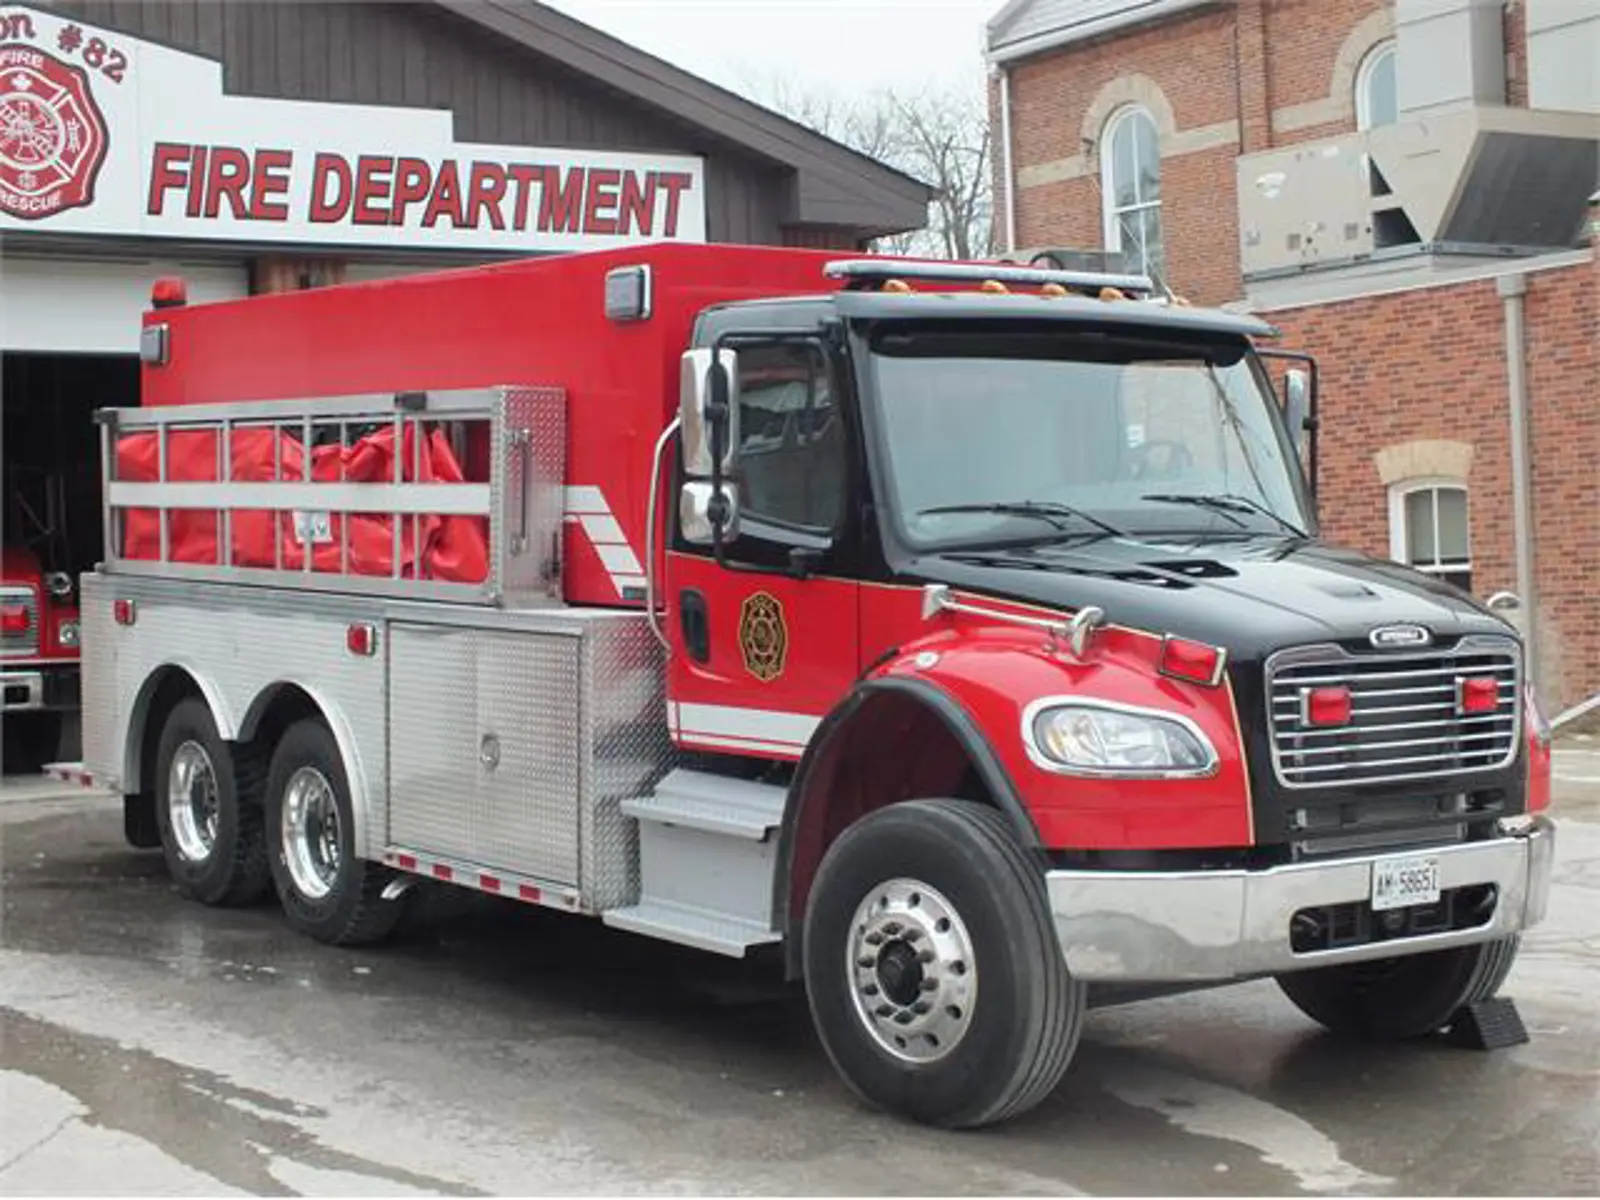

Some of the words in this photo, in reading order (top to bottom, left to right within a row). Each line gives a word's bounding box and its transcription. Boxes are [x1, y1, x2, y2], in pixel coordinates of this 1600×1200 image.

[0, 50, 44, 69] FIRE
[57, 24, 127, 84] #82
[147, 142, 293, 221] FIRE
[308, 152, 693, 237] DEPARTMENT
